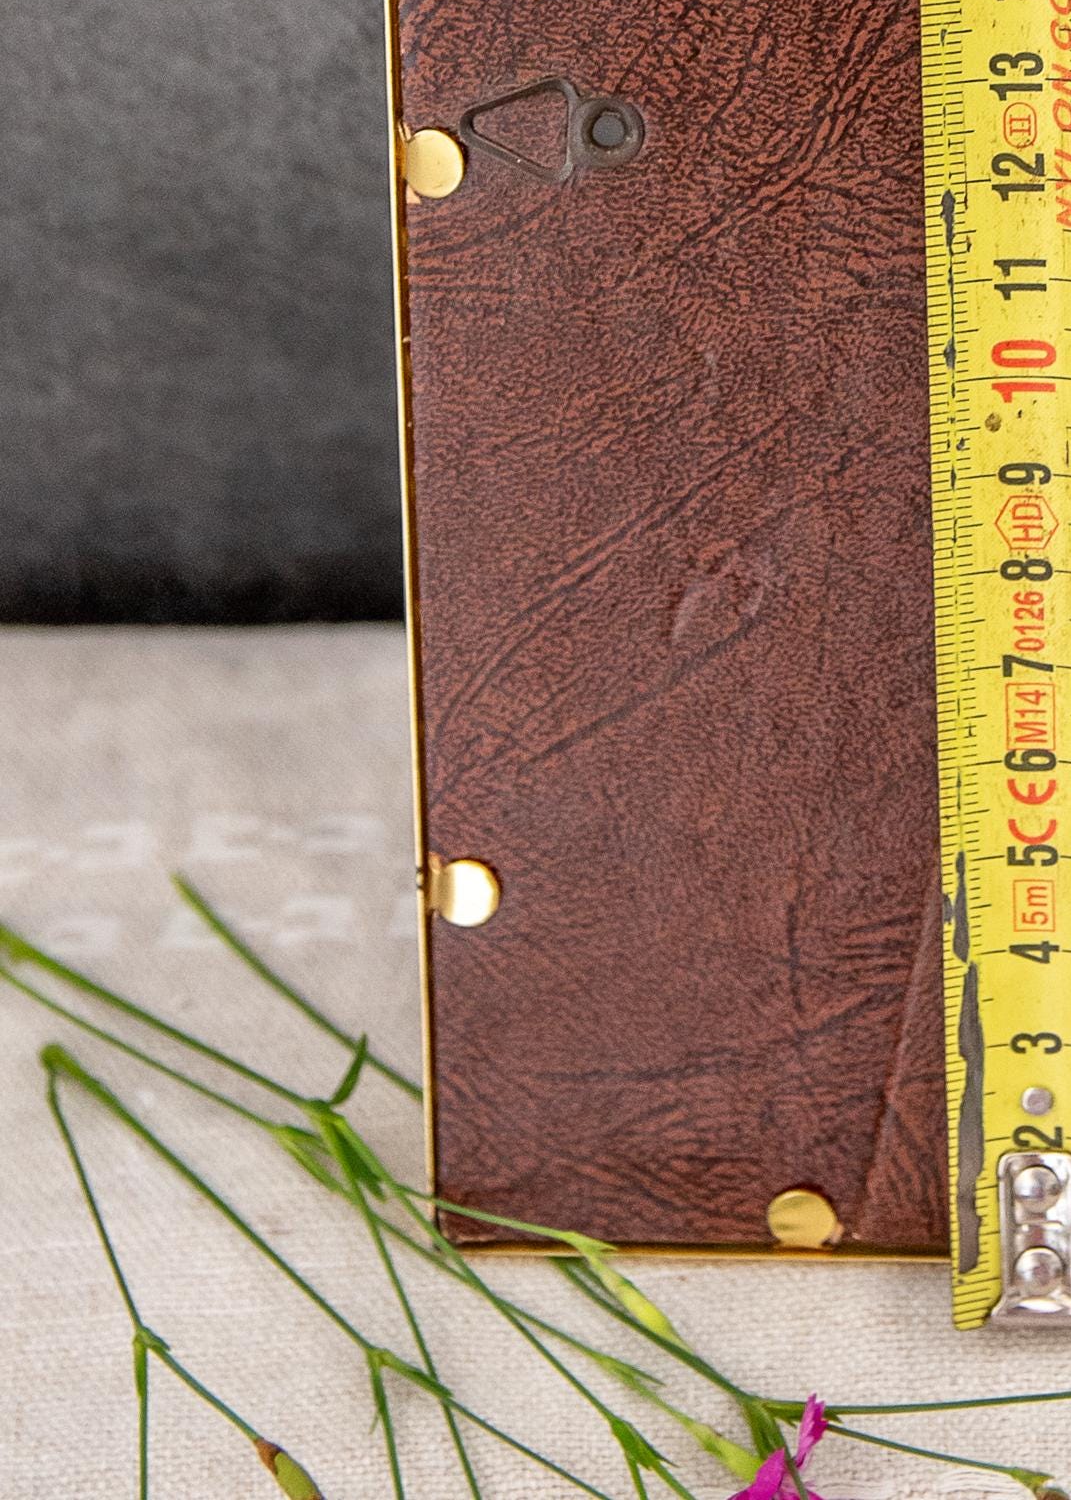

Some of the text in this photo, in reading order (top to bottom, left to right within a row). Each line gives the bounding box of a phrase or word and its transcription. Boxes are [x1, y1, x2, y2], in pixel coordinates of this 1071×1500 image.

[989, 52, 1044, 101] 13
[991, 153, 1046, 201] 12
[993, 259, 1047, 301] 11
[991, 339, 1057, 403] 10
[997, 462, 1052, 486] 9
[1011, 502, 1044, 542] HD
[1000, 558, 1053, 581] 8
[1013, 590, 1046, 653] 0126
[1002, 654, 1054, 678] 7
[1014, 689, 1048, 743] M14
[1004, 748, 1057, 772] 6
[1007, 844, 1059, 867] 5
[1009, 941, 1060, 964] 4
[1010, 1032, 1063, 1054] 3
[1013, 1125, 1064, 1149] 2
